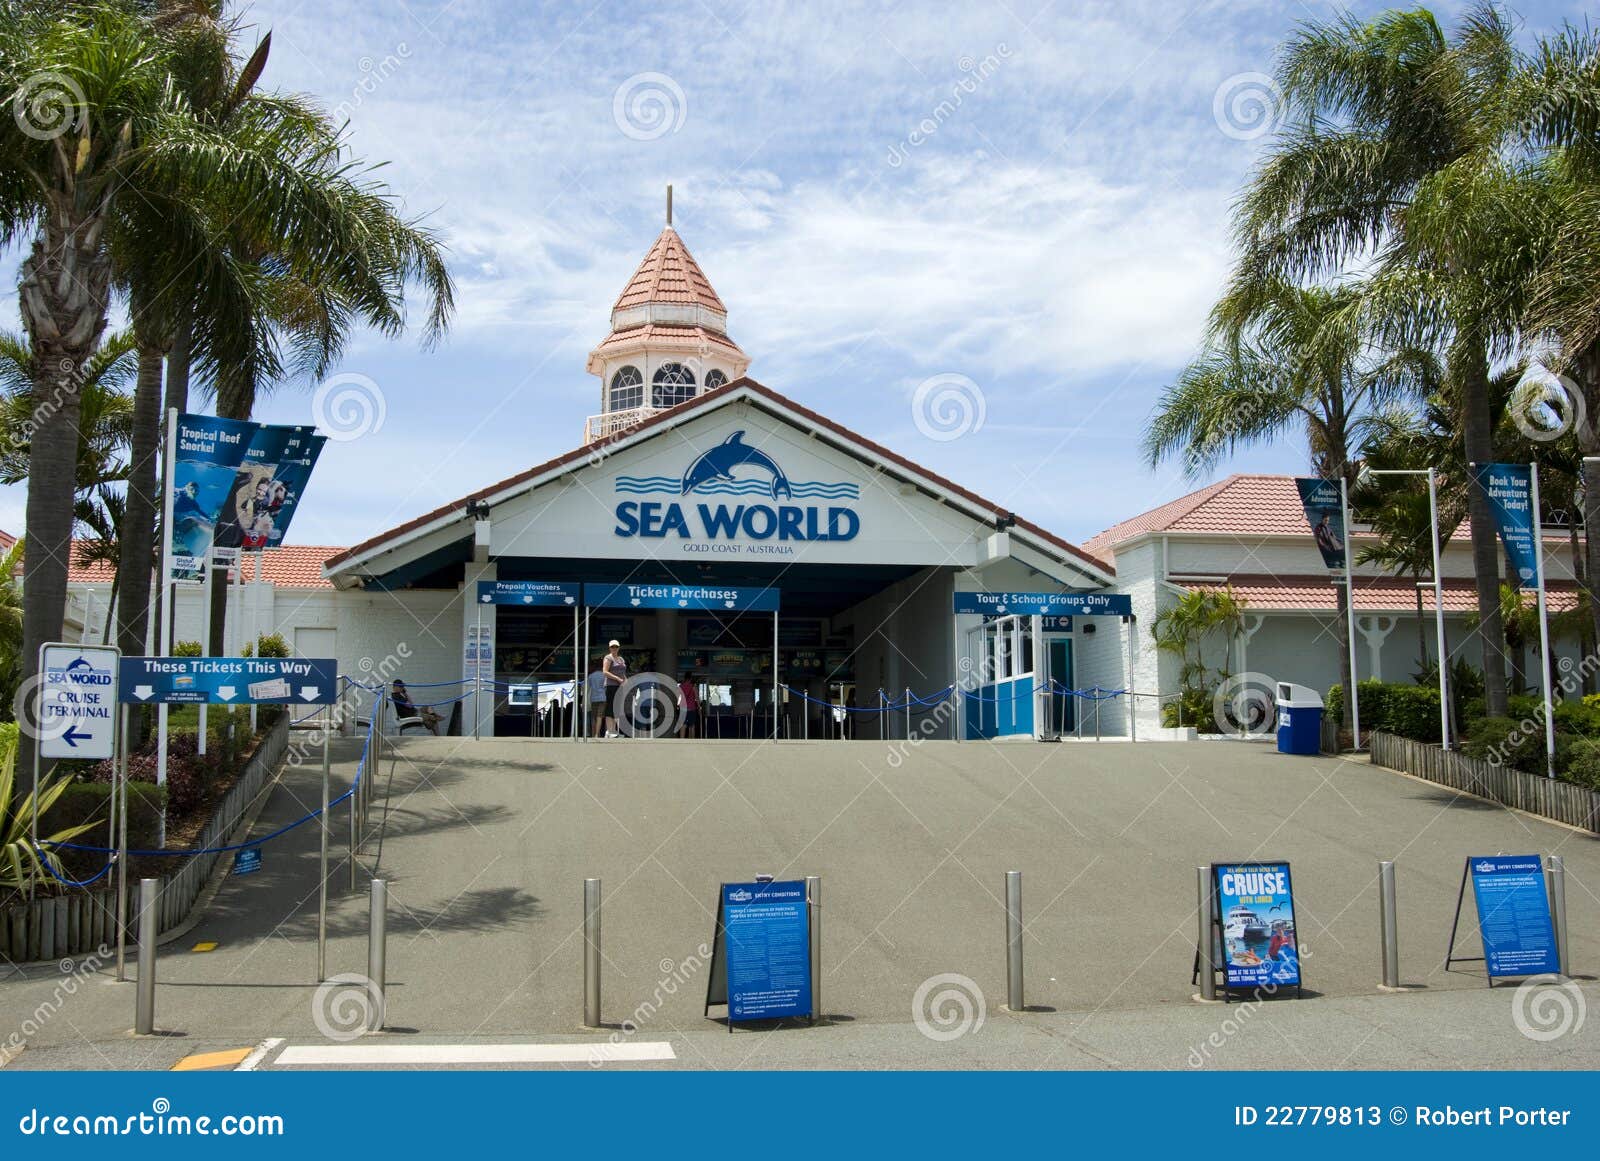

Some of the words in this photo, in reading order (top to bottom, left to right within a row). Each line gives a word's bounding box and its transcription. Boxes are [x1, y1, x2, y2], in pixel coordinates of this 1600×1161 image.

[181, 426, 216, 441] Tropical
[220, 431, 240, 444] Reef
[180, 439, 214, 453] Snorkel
[1489, 475, 1508, 487] Book
[1510, 476, 1527, 488] Your
[1488, 487, 1528, 499] Adventure
[1504, 499, 1528, 512] Today!
[614, 501, 691, 539] SEA
[696, 503, 861, 542] WORLD
[683, 543, 709, 553] GOLD
[711, 544, 741, 553] COAST
[746, 545, 793, 554] AUSTRALIA
[496, 582, 525, 591] Prepaid
[527, 583, 561, 591] Vouchers
[628, 586, 668, 598] Ticket
[671, 586, 738, 600] Purchases
[976, 593, 999, 604] Tour
[1011, 594, 1046, 605] School
[1049, 595, 1085, 607] Groups
[1087, 595, 1110, 607] Only
[143, 660, 186, 673] These
[191, 661, 243, 673] Tickets
[246, 661, 276, 673] This
[279, 662, 312, 676] Way
[48, 673, 67, 683] SEA
[69, 674, 112, 685] WORLD
[57, 691, 101, 703] CRUISE
[48, 705, 111, 718] TERMINAL
[1222, 872, 1287, 896] CRUISE
